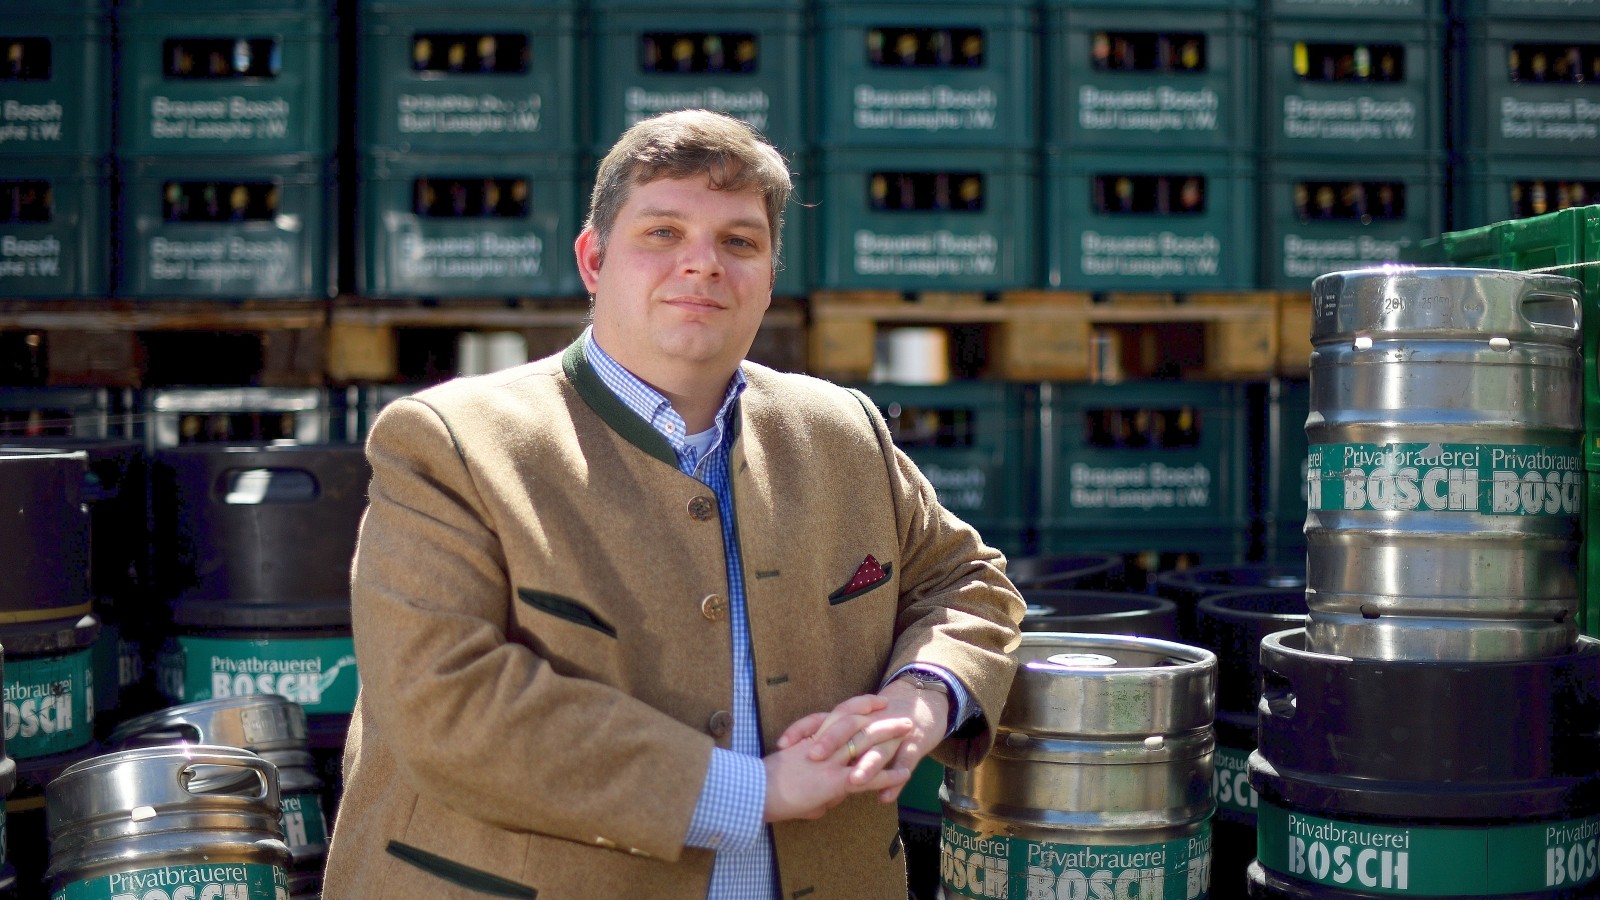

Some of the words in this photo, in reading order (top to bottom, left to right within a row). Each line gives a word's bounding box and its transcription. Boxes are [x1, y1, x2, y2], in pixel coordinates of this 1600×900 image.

[1344, 467, 1479, 511] BOSCH
[211, 656, 321, 672] Privatbrauerei
[212, 672, 321, 704] BOSCH
[4, 693, 72, 740] OSCH
[1288, 814, 1409, 848] Privatbrauerei
[941, 841, 1009, 899] OSCH
[1028, 843, 1166, 870] Privatbrauerei
[1288, 835, 1409, 890] BOSCH
[110, 863, 248, 893] Privatbrauerei
[1028, 866, 1165, 900] BOSCH
